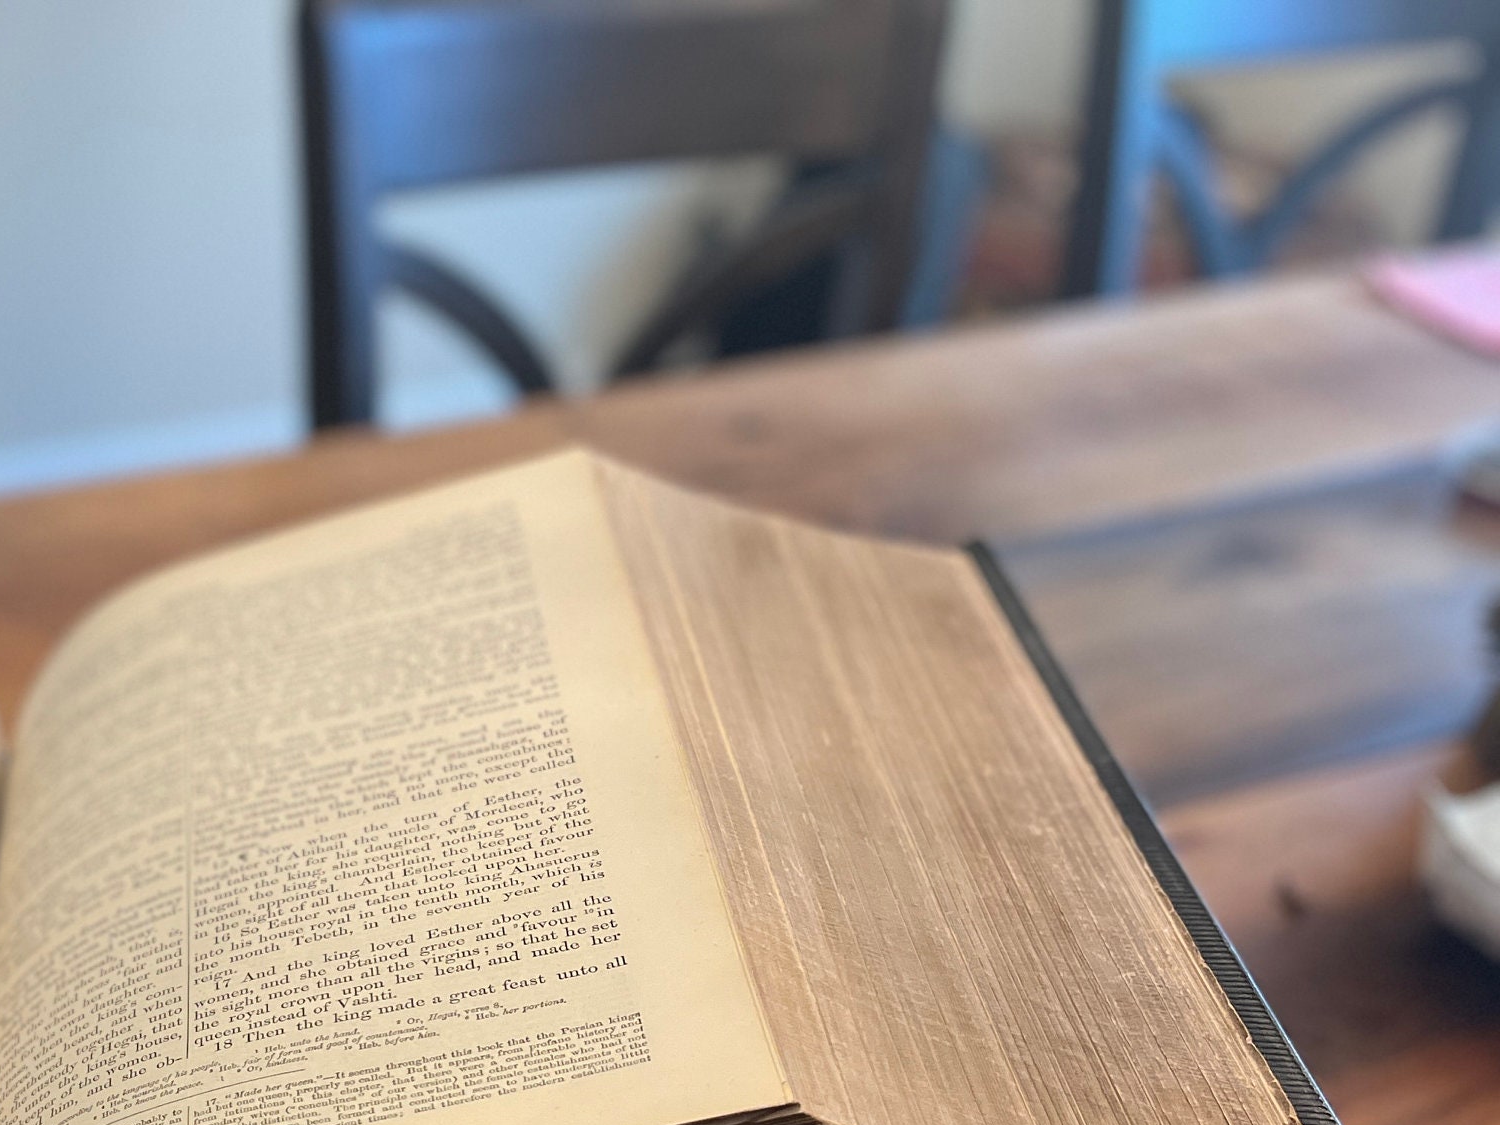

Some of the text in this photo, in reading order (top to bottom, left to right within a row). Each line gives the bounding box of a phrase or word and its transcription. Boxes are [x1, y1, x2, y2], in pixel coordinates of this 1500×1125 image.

[464, 786, 584, 821] Mordecai, who
[483, 776, 582, 805] Esther, the
[194, 858, 603, 962] into his house royal in the tenth month, which is
[194, 869, 605, 973] the month Tebeth, in the seventh year of his
[213, 849, 600, 945] 16 So Esther was taken unto king Ahasuerus
[194, 987, 254, 1008] women,
[260, 974, 290, 990] and
[299, 968, 327, 981] she
[337, 947, 409, 972] obtained
[419, 938, 466, 958] grace
[475, 926, 507, 942] and
[522, 914, 578, 932] favour
[598, 906, 615, 917] in
[194, 1008, 216, 1020] his
[222, 993, 262, 1011] sight
[268, 984, 310, 999] more
[316, 974, 353, 988] than
[360, 965, 380, 978] all
[387, 960, 415, 973] the
[496, 940, 514, 951] so
[521, 930, 559, 946] that
[565, 926, 586, 937] he
[592, 918, 619, 932] set
[214, 894, 612, 990] 17 And the king loved Esther above all the
[143, 995, 183, 1014] when
[194, 967, 237, 985] reign.
[194, 933, 622, 1032] the royal crown upon her head, and made her
[214, 955, 628, 1052] 18 Then the king made a great feast unto all
[135, 1032, 182, 1051] house,
[149, 1006, 183, 1024] unto
[151, 1018, 183, 1034] that
[194, 989, 398, 1048] queen instead of Vashti.
[106, 1050, 161, 1076] women.
[265, 1083, 282, 1092] her
[349, 1065, 380, 1077] seems
[385, 1051, 448, 1071] throughout
[451, 1047, 472, 1058] this
[477, 1040, 504, 1053] book
[507, 1035, 530, 1046] that
[536, 1030, 555, 1040] the
[560, 1020, 604, 1034] Persian
[608, 1012, 641, 1024] kings
[87, 1079, 112, 1098] and
[122, 1067, 147, 1082] she
